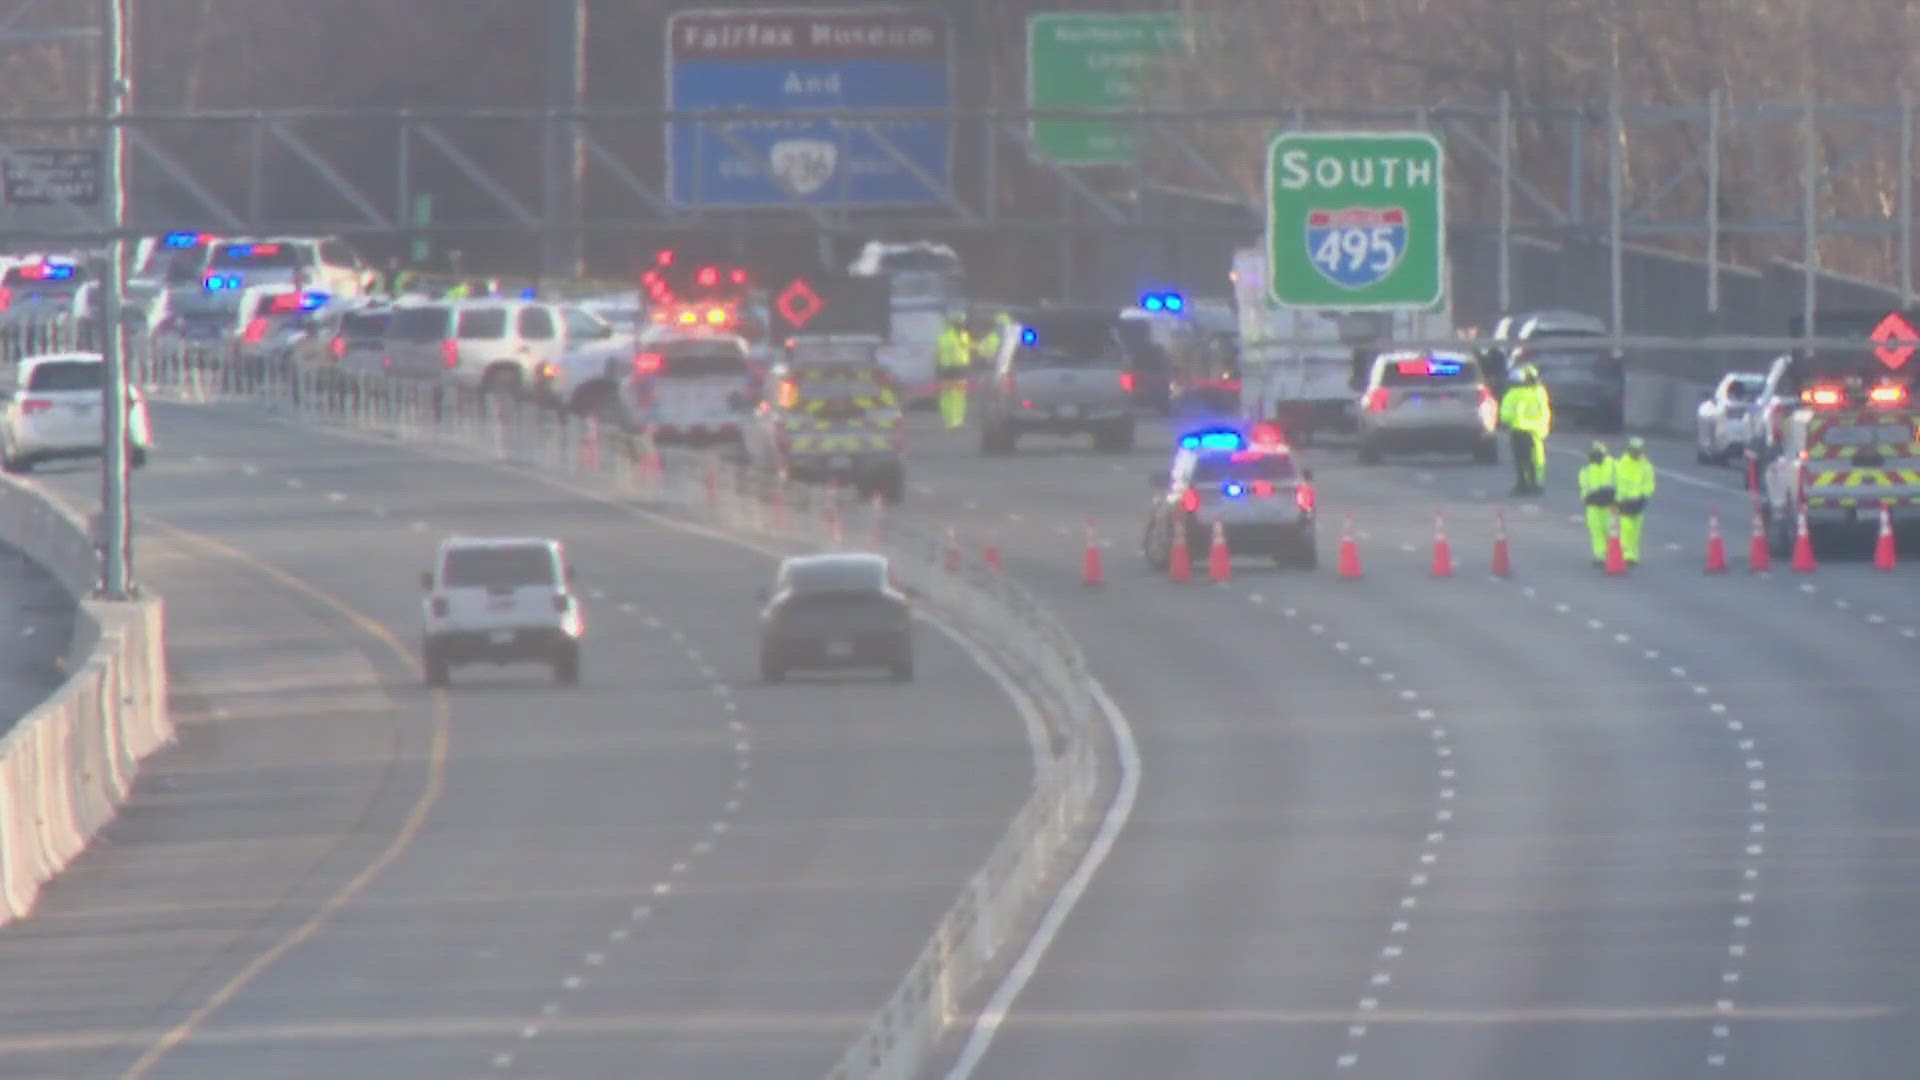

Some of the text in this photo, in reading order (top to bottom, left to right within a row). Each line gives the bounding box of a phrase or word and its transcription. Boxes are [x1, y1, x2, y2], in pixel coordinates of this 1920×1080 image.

[683, 23, 935, 48] Fairfax Museum
[784, 71, 841, 93] And
[1281, 150, 1431, 189] SOUTH
[1315, 227, 1396, 272] 495
